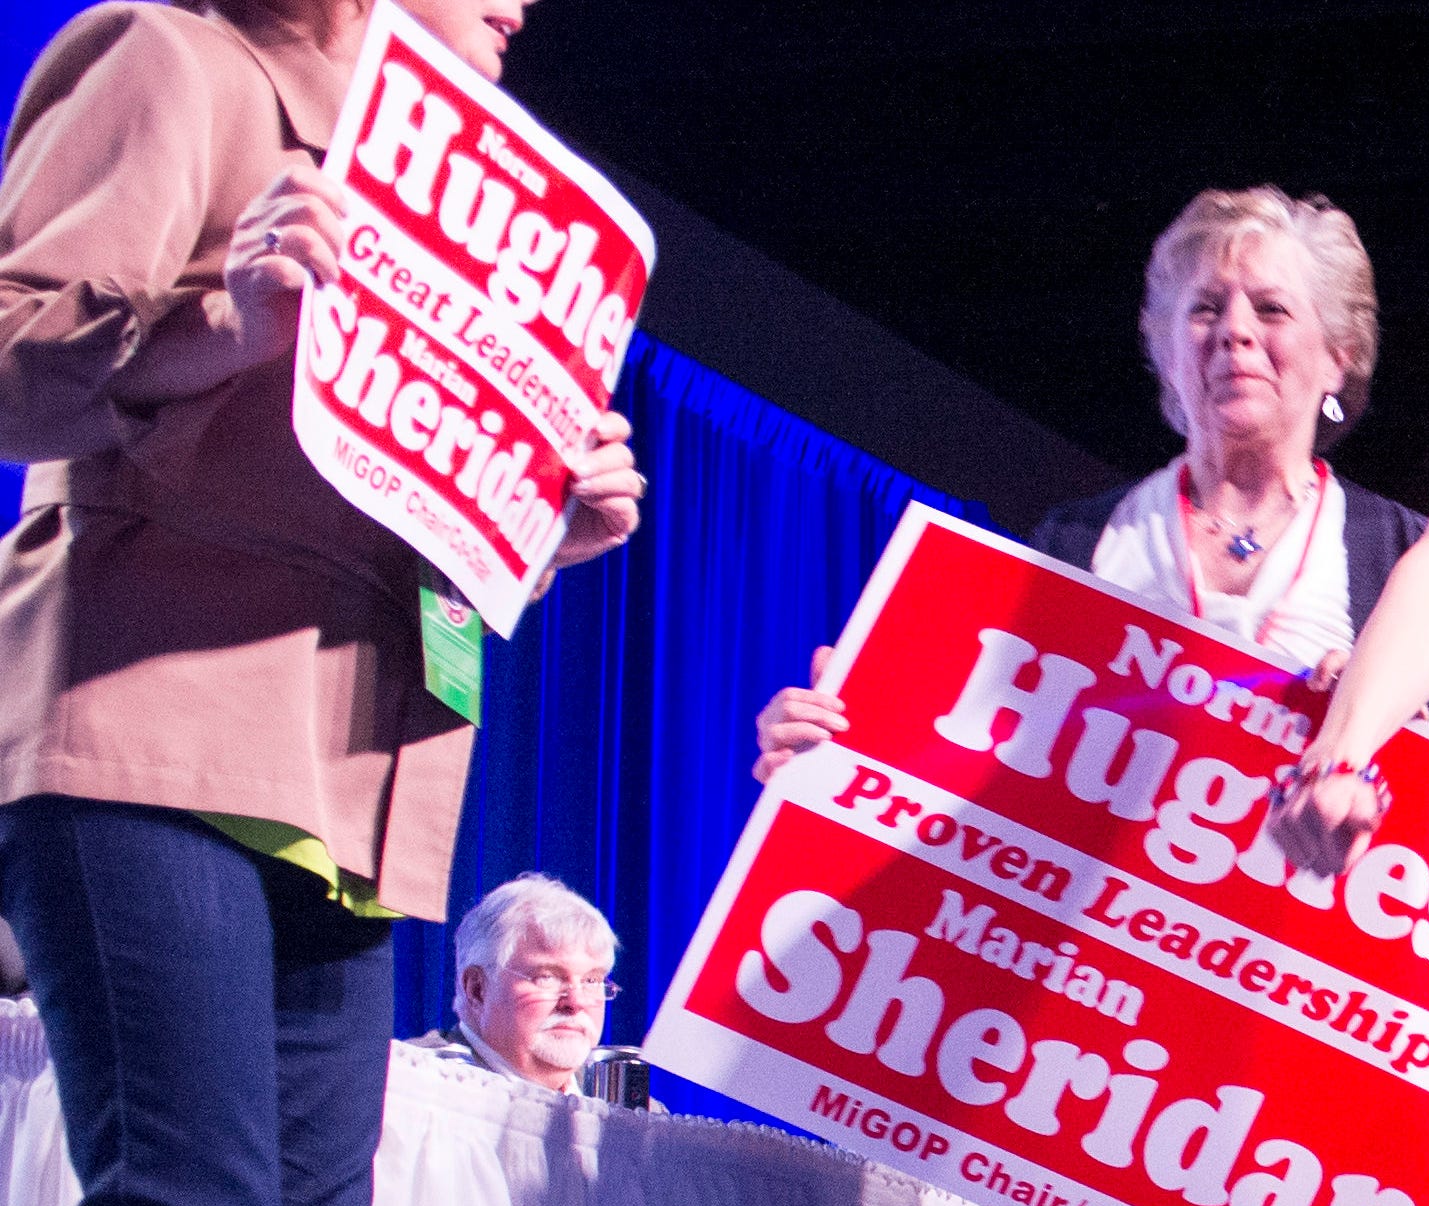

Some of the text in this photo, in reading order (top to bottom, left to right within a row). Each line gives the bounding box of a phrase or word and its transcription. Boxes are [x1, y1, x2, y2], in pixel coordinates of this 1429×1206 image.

[477, 122, 550, 198] Norm
[347, 223, 453, 322] Great
[399, 332, 479, 408] Marian
[306, 287, 566, 568] Sheridan
[332, 434, 402, 497] MiGOP
[1106, 623, 1313, 756] Norm
[832, 765, 1075, 903] Proven
[925, 888, 1146, 1027] Marian
[809, 1084, 949, 1161] MiGOP
